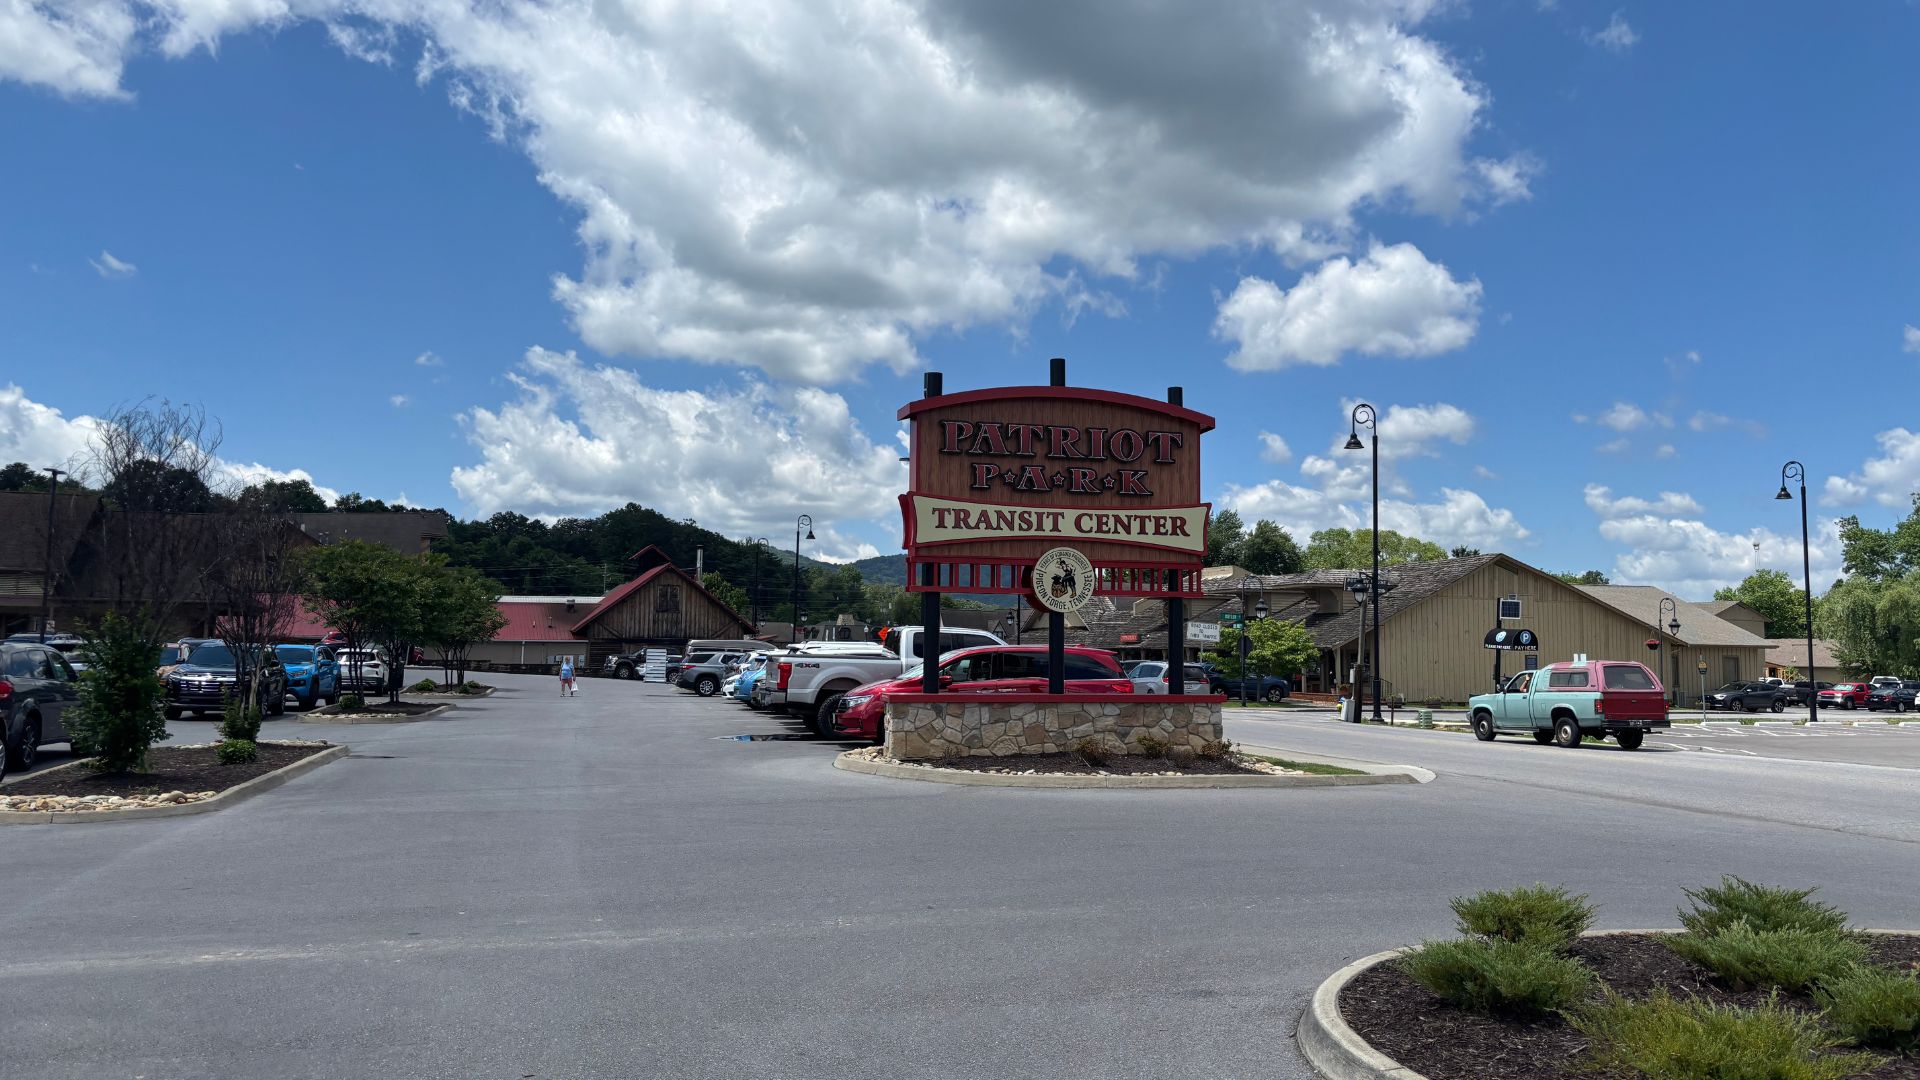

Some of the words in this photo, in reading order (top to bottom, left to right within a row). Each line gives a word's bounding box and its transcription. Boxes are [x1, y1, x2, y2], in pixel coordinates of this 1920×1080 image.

[941, 420, 1183, 463] PATRIOT
[932, 507, 1065, 533] TRANSIT
[1074, 513, 1190, 537] CENTER
[1036, 572, 1048, 599] PIGEON
[1069, 574, 1093, 608] TENNESSEE
